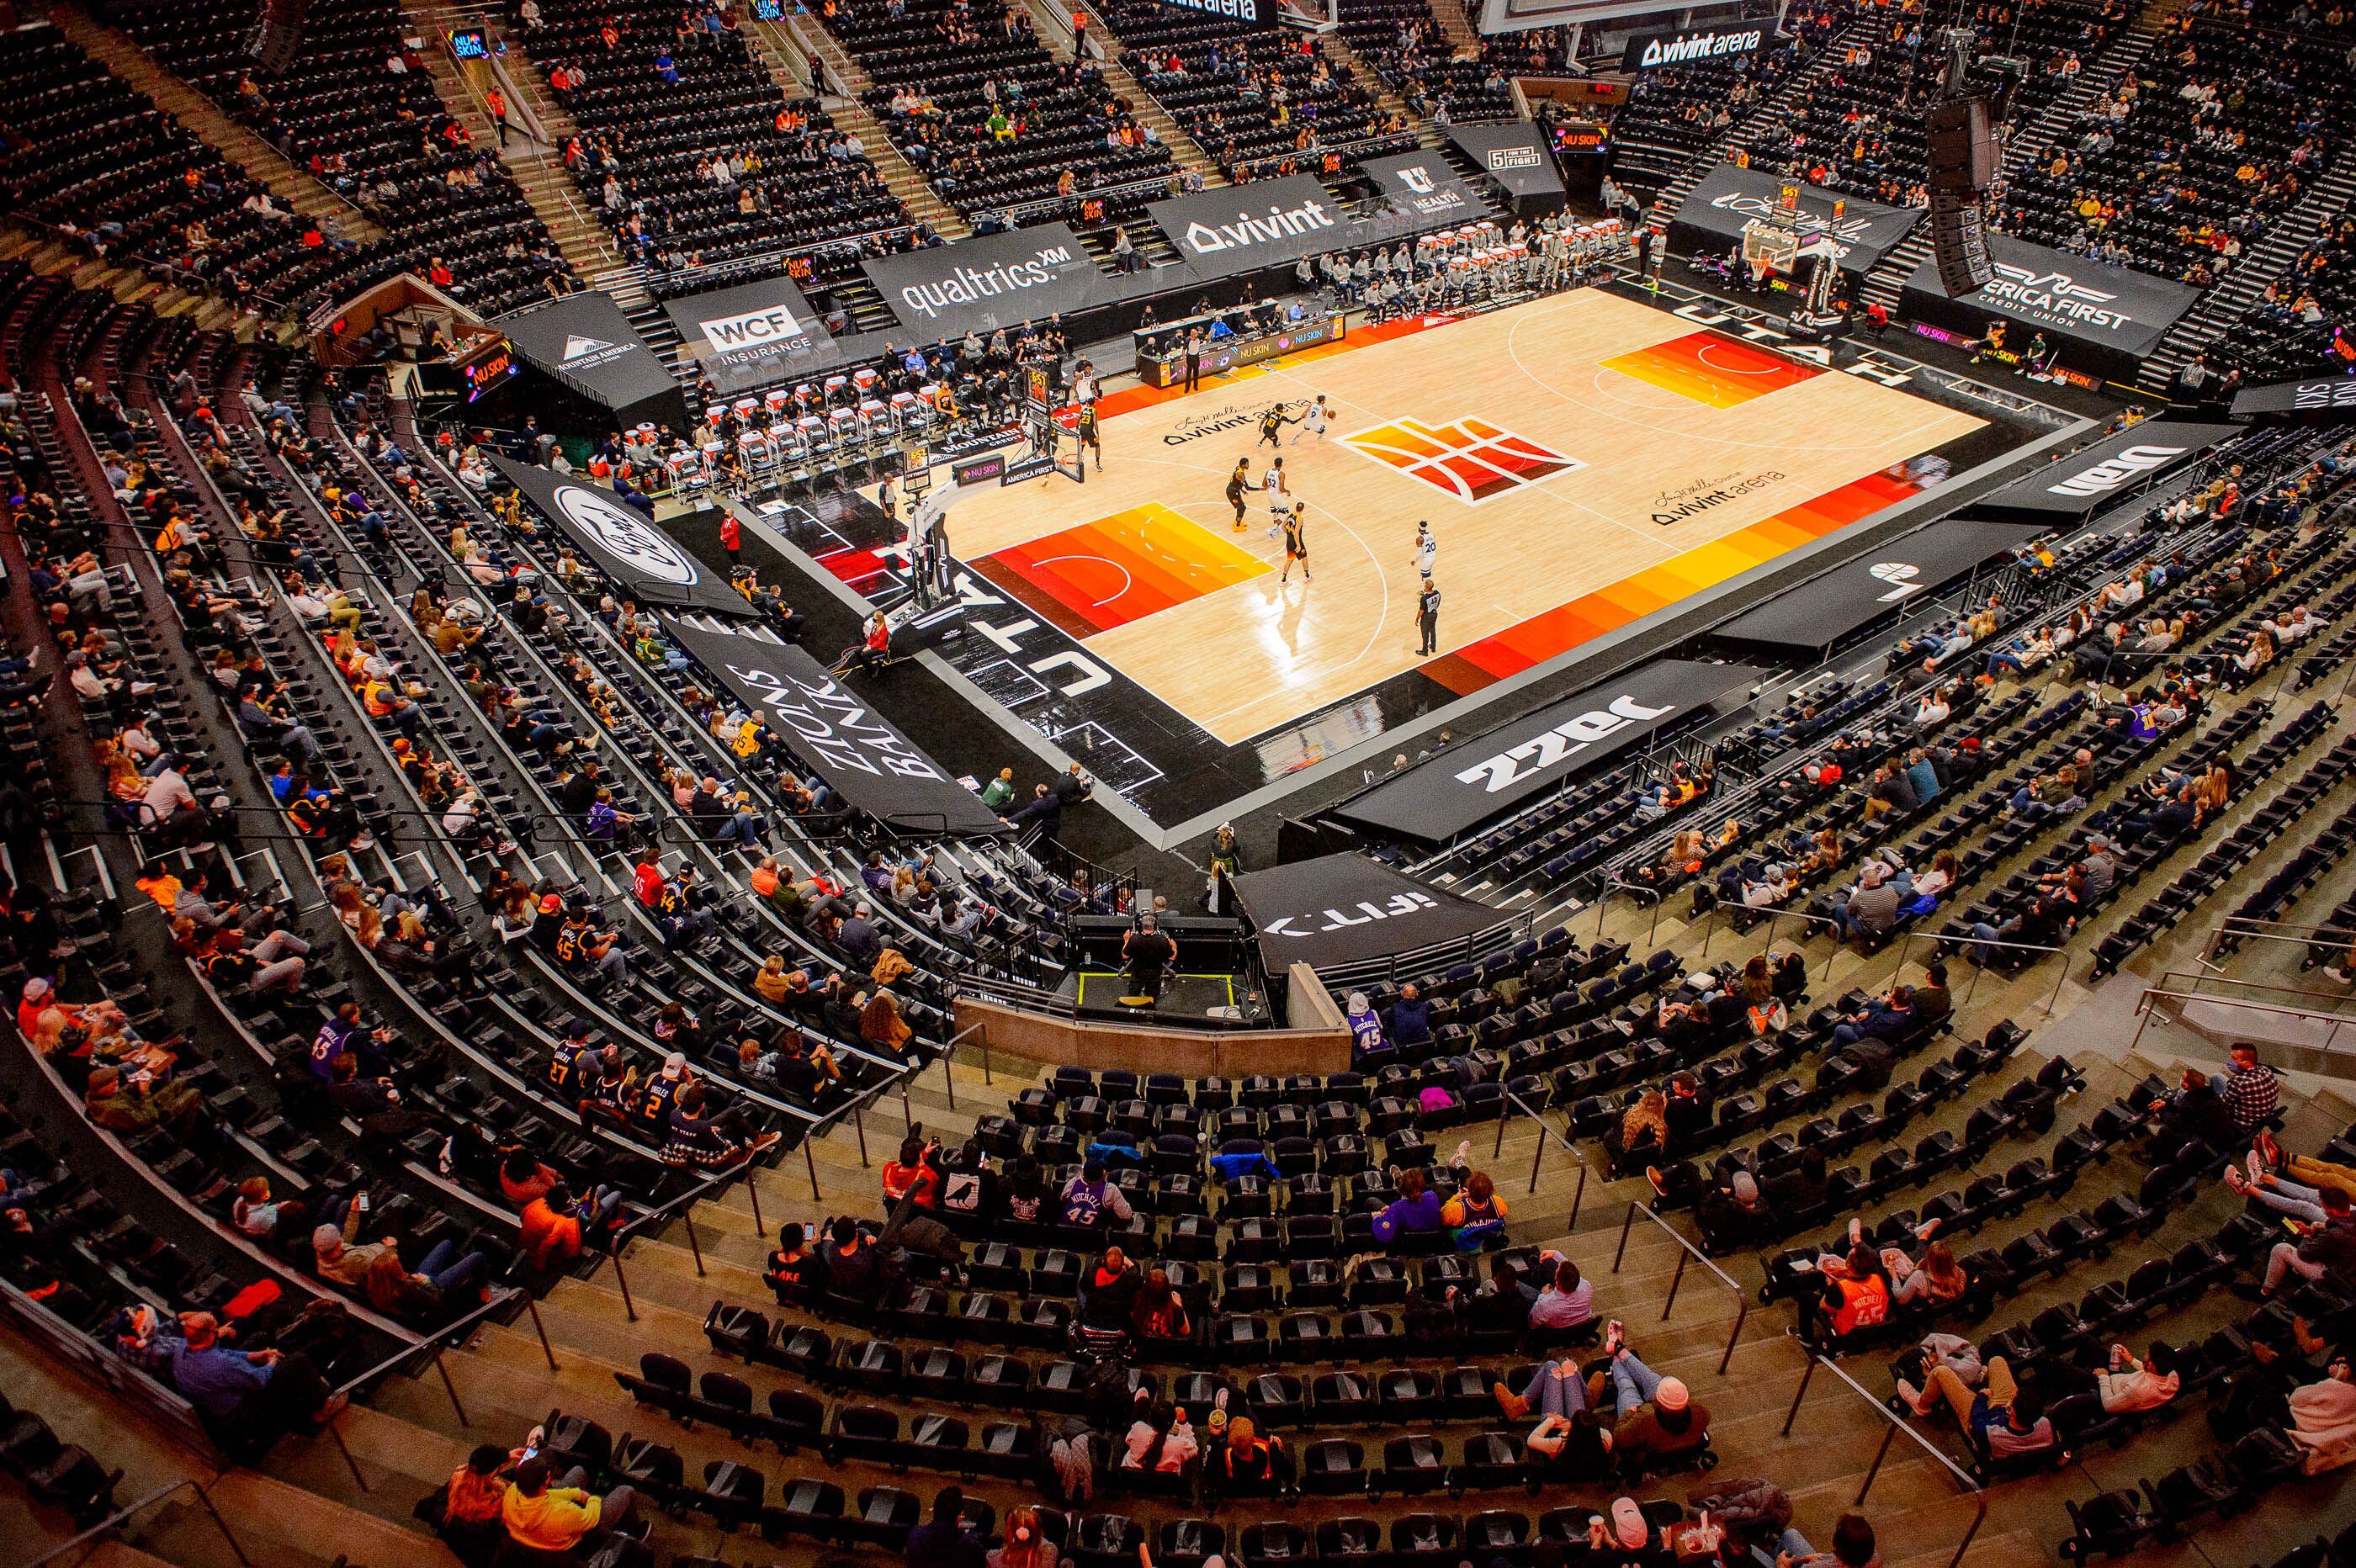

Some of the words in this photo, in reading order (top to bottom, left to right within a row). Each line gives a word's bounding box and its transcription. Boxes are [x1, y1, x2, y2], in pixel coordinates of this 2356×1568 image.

[454, 35, 471, 47] NU
[1713, 29, 1762, 55] arena
[456, 44, 482, 56] SKIN
[1562, 135, 1579, 146] NU
[1579, 135, 1600, 146] SKIN
[1492, 152, 1504, 167] 5
[1509, 156, 1536, 166] FIGHT
[1085, 201, 1096, 211] NU
[1413, 192, 1461, 209] HEALTH
[1085, 209, 1102, 220] SKIN
[1221, 199, 1335, 246] vivint
[788, 259, 802, 270] NU
[788, 267, 812, 278] SKIN
[1978, 294, 2029, 314] CREDIT
[2032, 310, 2077, 328] UNION
[1982, 278, 2052, 310] ERICA
[2053, 298, 2131, 330] FIRST
[711, 312, 785, 345] WCF
[1916, 324, 1930, 338] NU
[1929, 328, 1950, 342] SKIN
[1296, 335, 1306, 345] NU
[1307, 329, 1324, 342] SKIN
[599, 343, 637, 359] AMERICA
[720, 337, 812, 366] INSURANCE
[1240, 349, 1252, 359] NU
[1253, 343, 1271, 356] SKIN
[1673, 305, 1913, 387] UTAH
[603, 354, 621, 364] UNION
[1997, 349, 2019, 364] SKIN
[473, 368, 489, 384] NU
[489, 354, 509, 377] SKIN
[2067, 371, 2091, 387] SKIN
[1081, 414, 1091, 425] 23
[1266, 417, 1276, 429] 10
[1310, 411, 1317, 419] 9
[1186, 414, 1255, 438] vivint
[941, 427, 1021, 454] MOUNTAIN
[989, 433, 1024, 448] CREDIT
[971, 468, 983, 478] NU
[983, 463, 999, 475] SKIN
[1006, 469, 1035, 485] AMERICA
[1033, 464, 1053, 478] FIRST
[1267, 478, 1276, 488] 32
[1670, 490, 1736, 516] vivint
[1729, 470, 1787, 495] arena
[581, 504, 678, 567] Ford
[1425, 542, 1436, 554] 20
[725, 664, 884, 776] ZIONS
[735, 734, 748, 749] 45
[660, 889, 677, 914] 44
[1353, 1020, 1377, 1035] MITCHELL
[1360, 1028, 1381, 1050] 45
[549, 1061, 569, 1085] 27
[650, 1085, 670, 1099] INGLES
[645, 1094, 662, 1120] 2
[1070, 1191, 1101, 1210] MITCHELL
[1066, 1206, 1098, 1225] 45
[1852, 1295, 1883, 1310] MITCHELL
